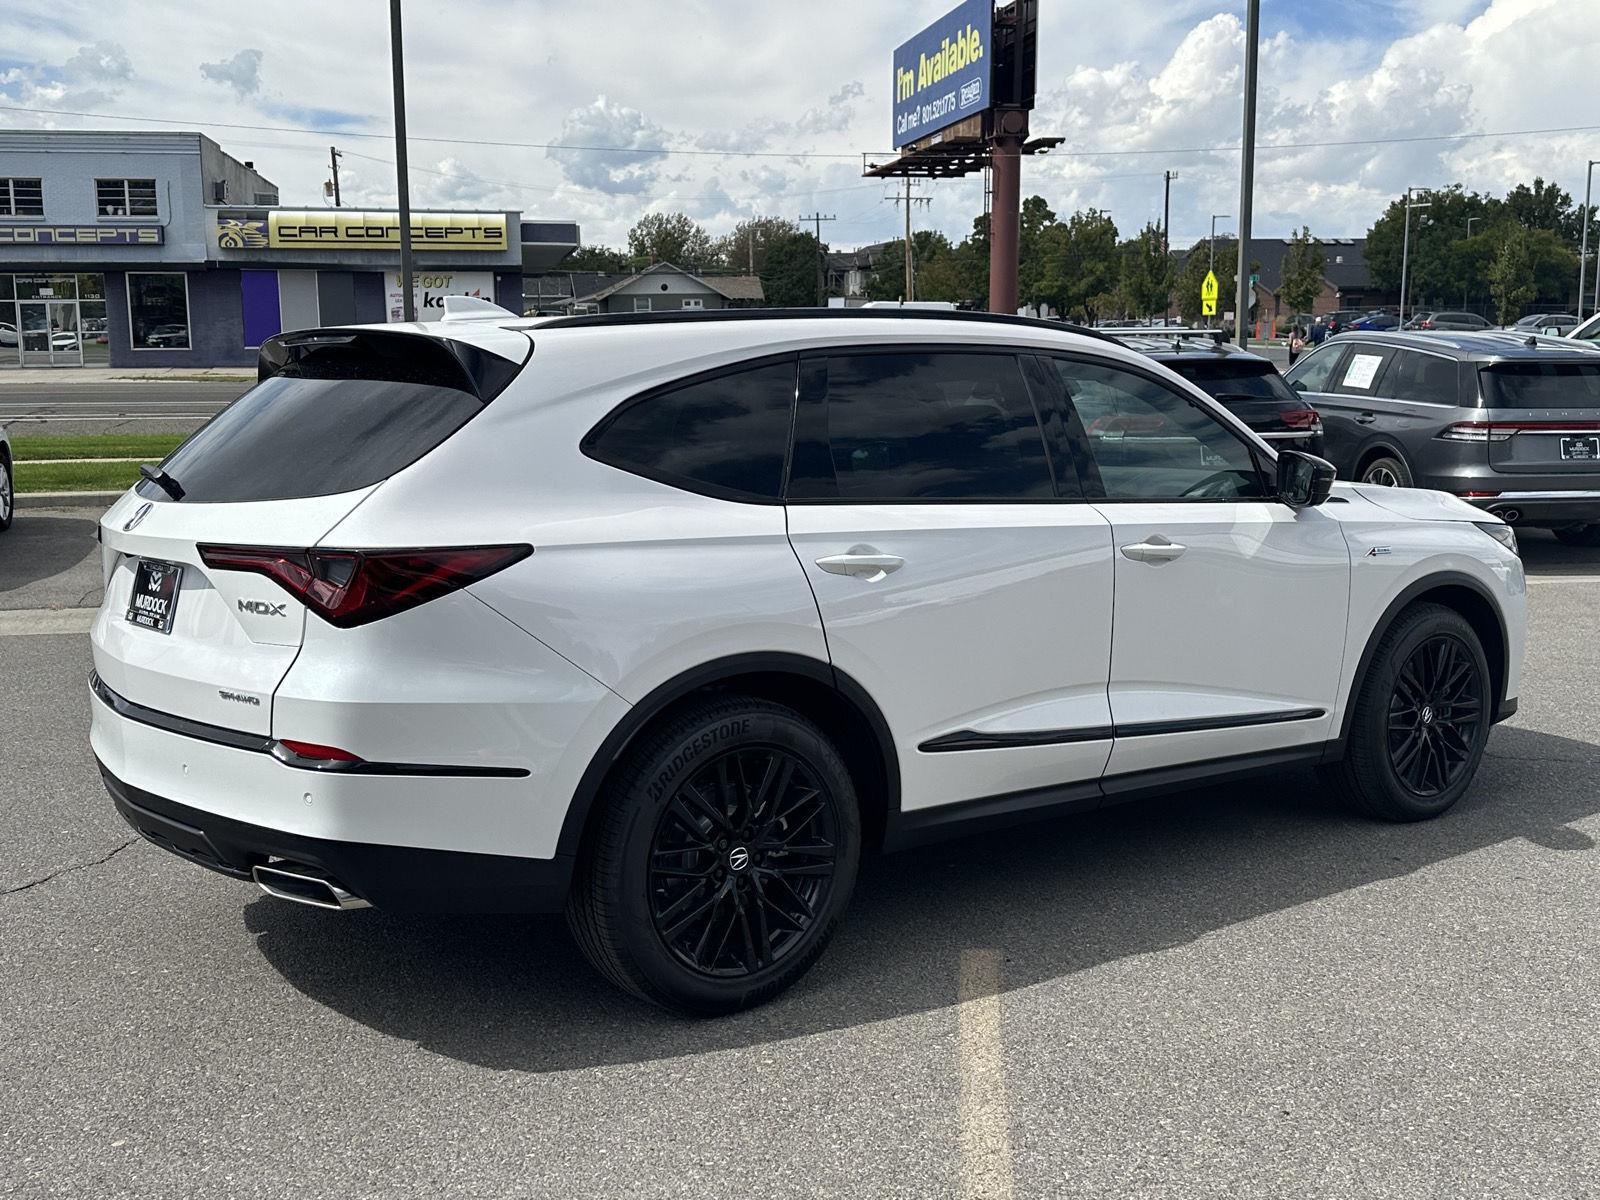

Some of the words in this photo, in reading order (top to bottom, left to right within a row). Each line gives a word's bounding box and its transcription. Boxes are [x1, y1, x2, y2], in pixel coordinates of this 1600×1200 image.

[897, 66, 914, 104] I'm
[917, 23, 983, 92] Available.
[897, 112, 907, 135] Call
[908, 105, 920, 129] me?
[278, 225, 338, 238] CAR
[422, 274, 453, 288] GOT
[135, 593, 168, 615] MURDOCK
[238, 599, 287, 617] MDX
[645, 719, 750, 802] BRIDGESTONE
